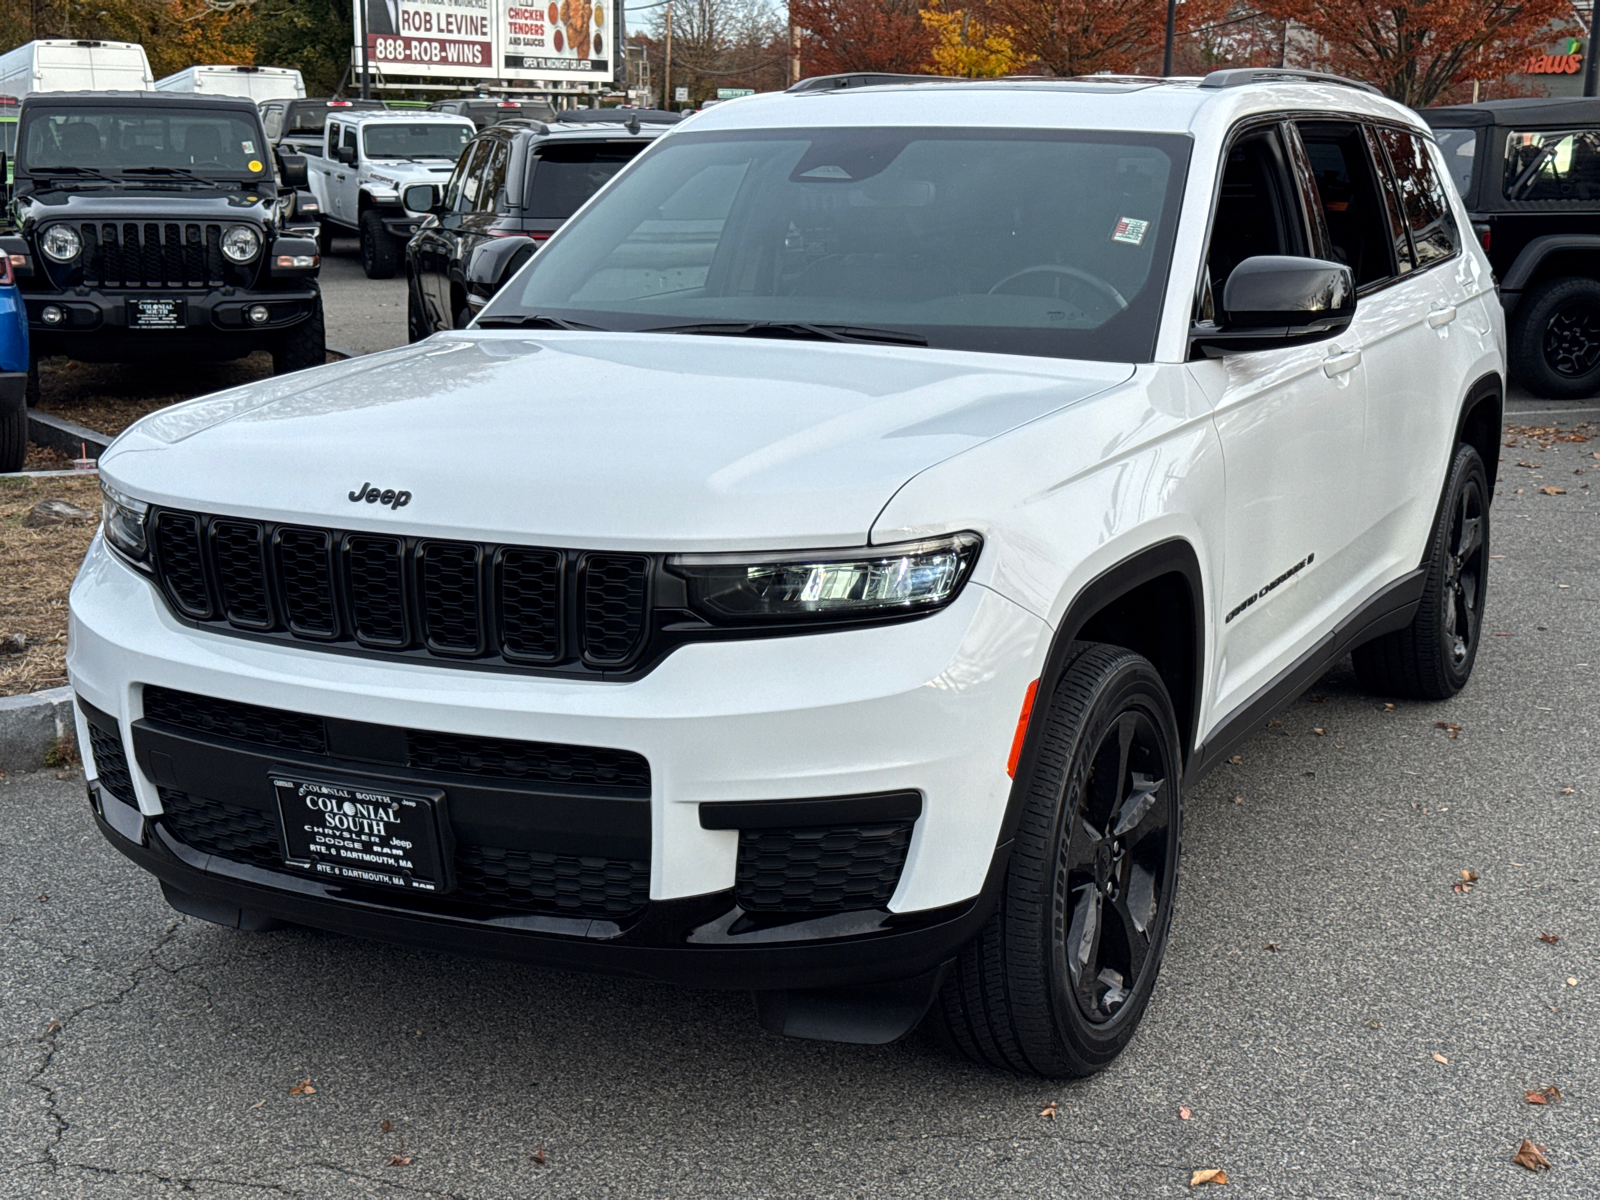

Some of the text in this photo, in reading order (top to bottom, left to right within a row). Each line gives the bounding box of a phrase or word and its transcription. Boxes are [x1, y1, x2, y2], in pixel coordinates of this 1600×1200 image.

[401, 9, 488, 36] ROB LEVINE
[508, 7, 545, 21] CHICKEN
[508, 22, 545, 36] TENDERS
[376, 38, 482, 63] 888-ROB-WINS
[509, 37, 545, 47] AND SAUCES
[348, 482, 412, 510] Jeep
[302, 783, 351, 798] COLONIAL
[355, 792, 392, 803] SOUTH
[401, 799, 417, 808] Jeep
[306, 795, 401, 824] COLONIAL
[324, 812, 386, 836] SOUTH
[303, 825, 413, 849] CHRYSLER Jeep
[315, 835, 404, 856] DODGE RAM
[309, 844, 330, 855] RTE.
[340, 849, 398, 867] DARTMOUTH,
[398, 859, 414, 868] MA
[316, 864, 334, 875] RTE.
[334, 867, 340, 875] 6
[342, 868, 392, 885] DARTMOUTH,
[392, 876, 405, 886] MA
